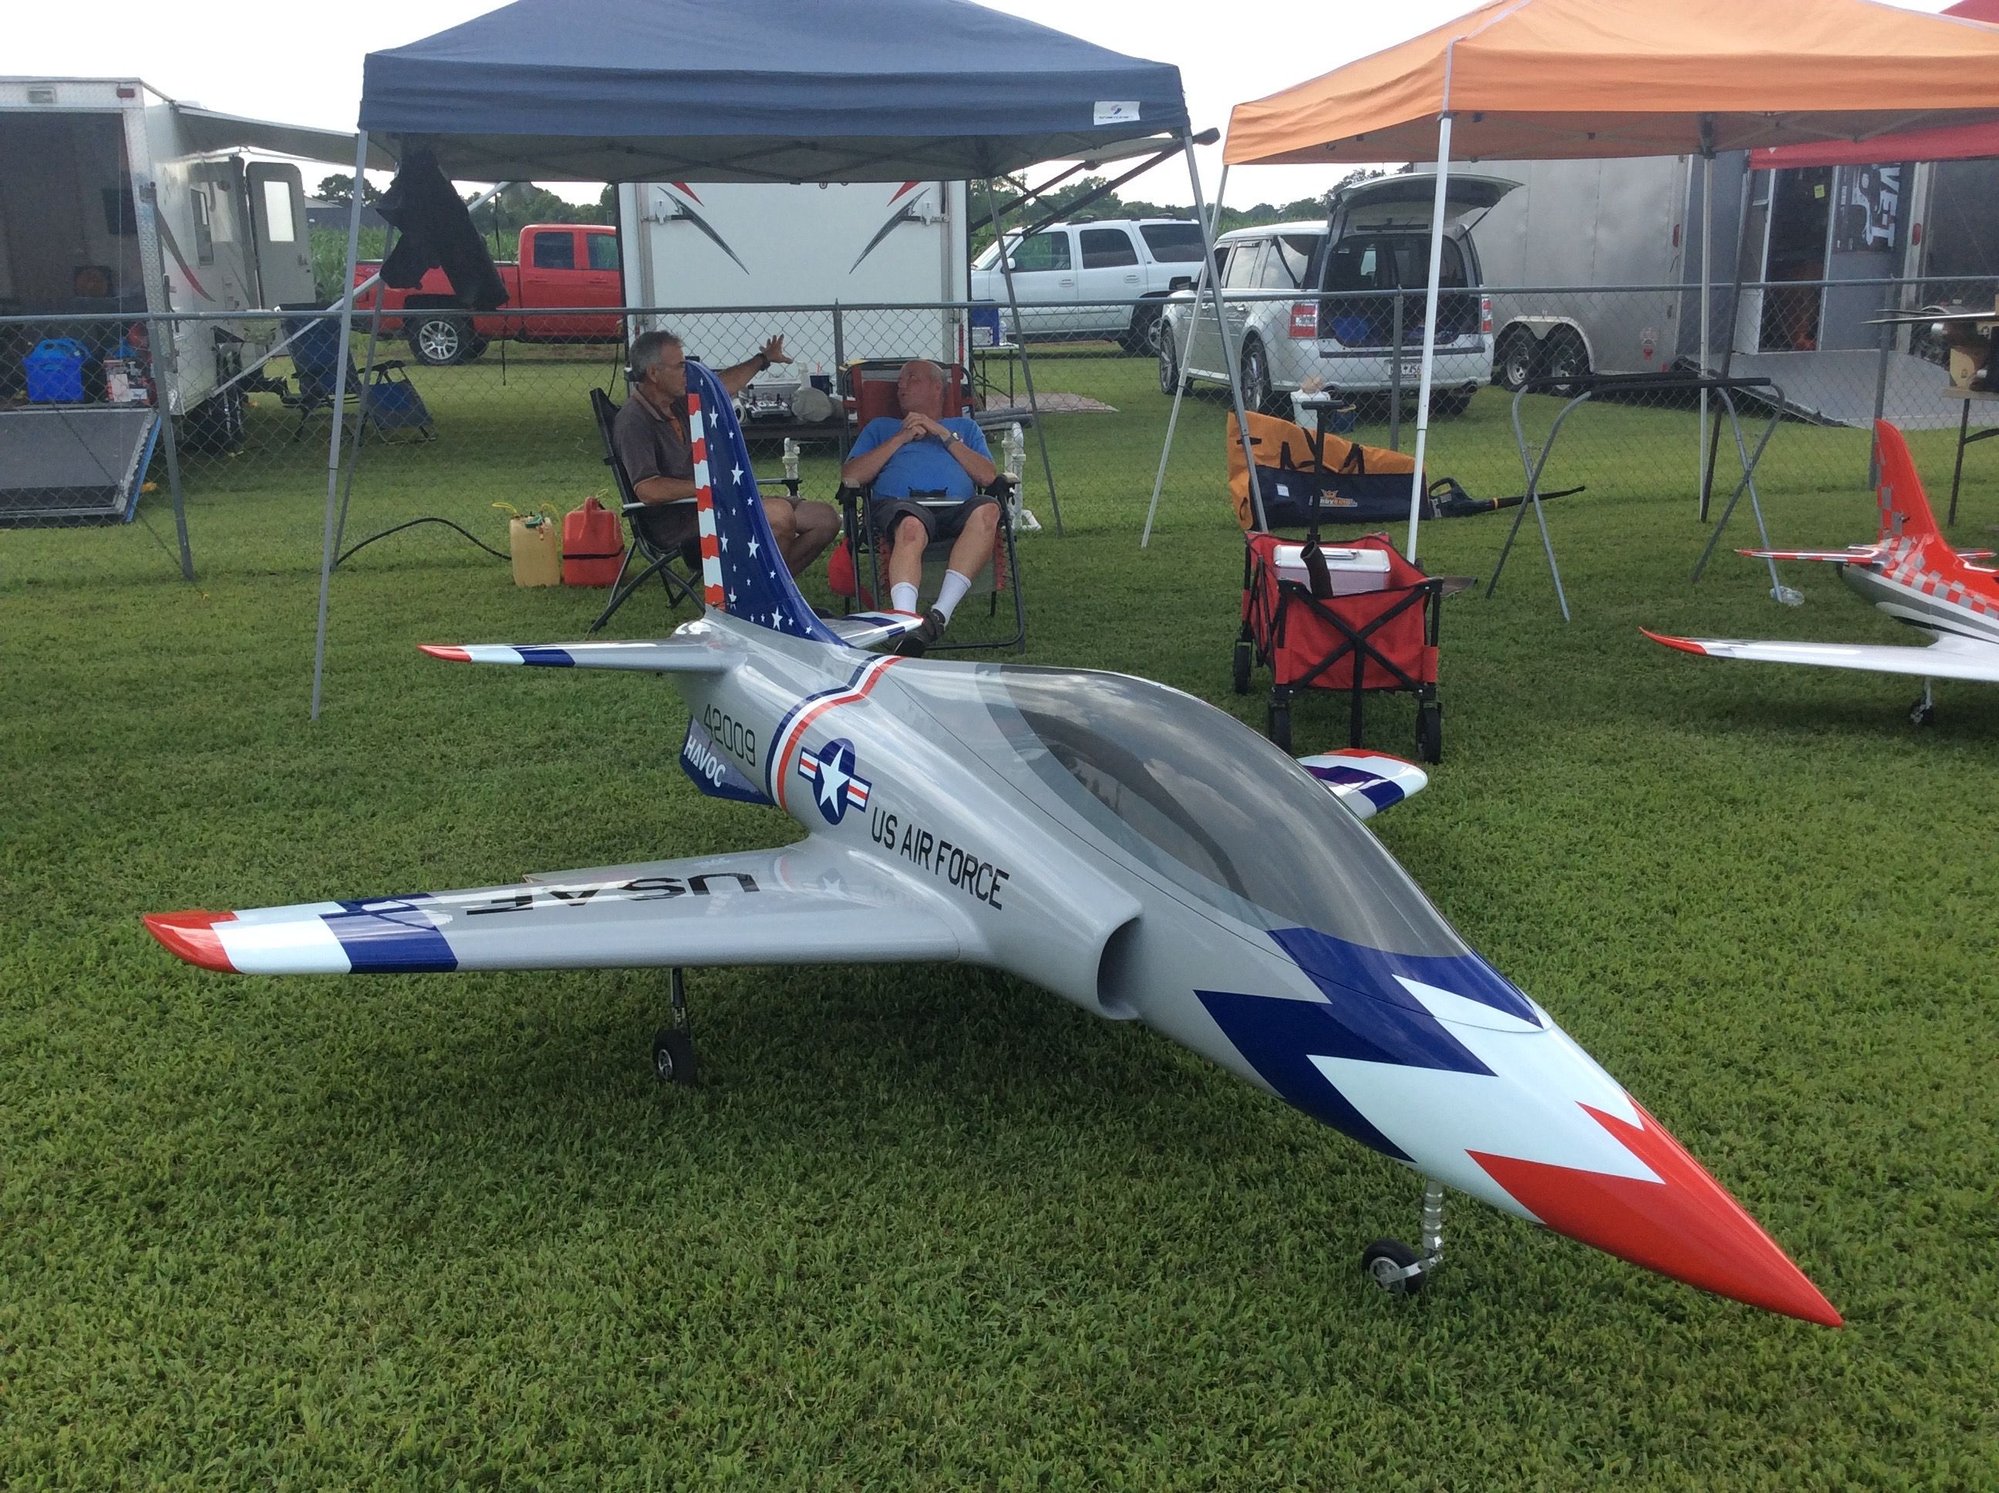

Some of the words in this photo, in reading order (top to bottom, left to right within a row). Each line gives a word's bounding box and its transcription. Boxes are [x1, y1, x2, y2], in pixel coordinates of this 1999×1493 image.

[1871, 165, 1901, 248] VE-T
[683, 735, 726, 788] HAVOC
[703, 704, 756, 767] 42009
[871, 806, 898, 850] US
[900, 823, 934, 871] AIR
[935, 840, 1010, 911] FORCE
[466, 872, 760, 915] USAF
